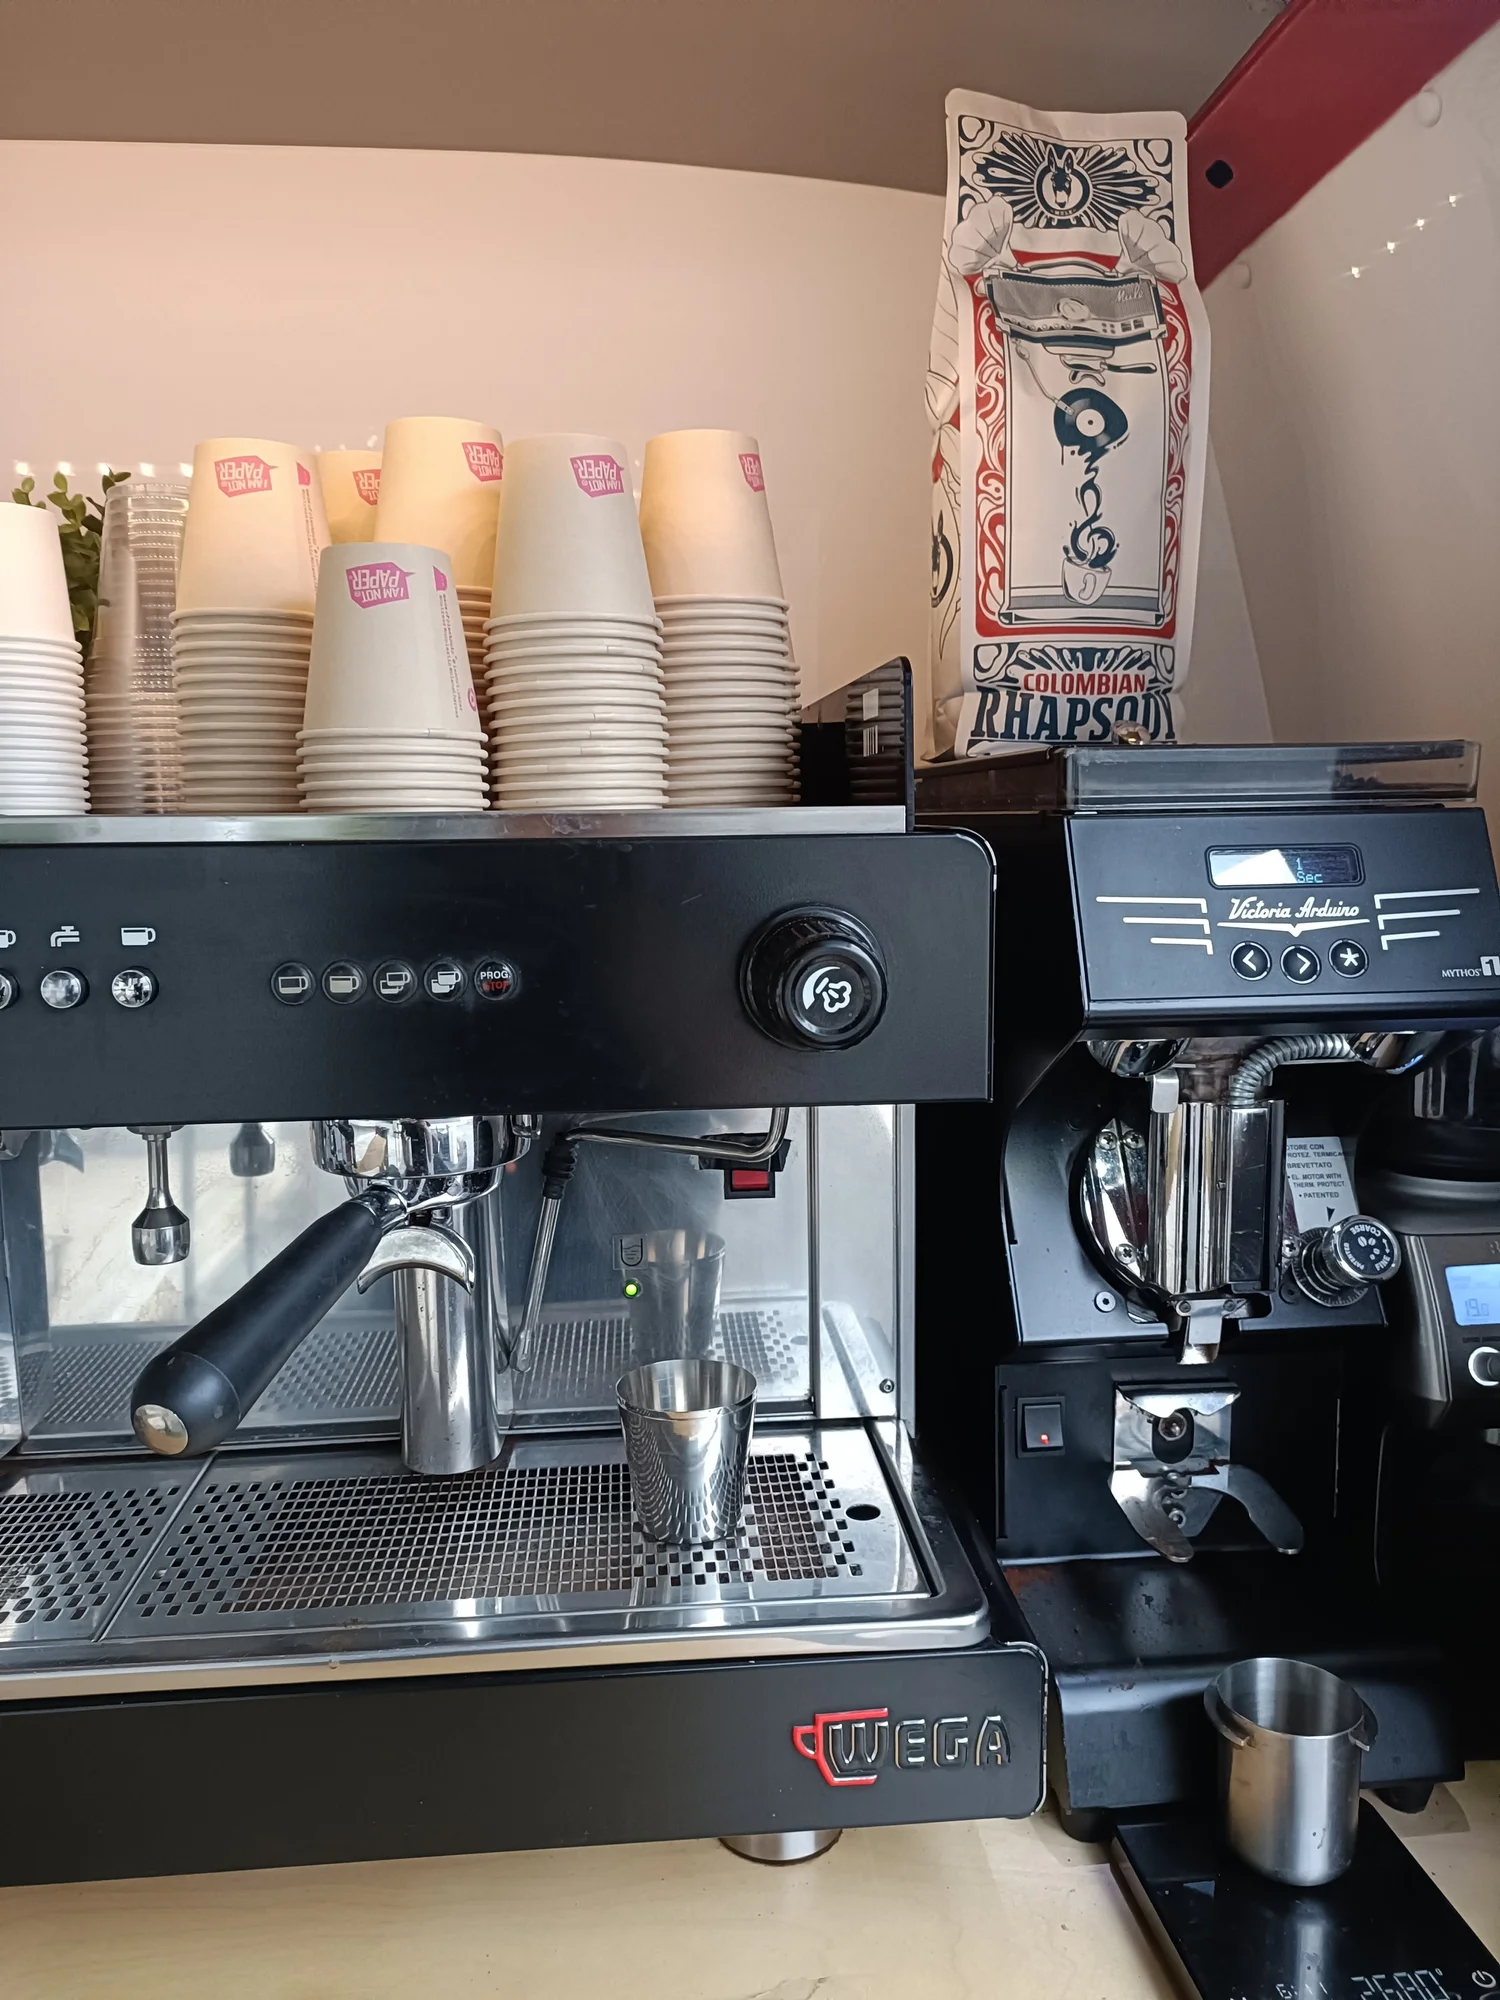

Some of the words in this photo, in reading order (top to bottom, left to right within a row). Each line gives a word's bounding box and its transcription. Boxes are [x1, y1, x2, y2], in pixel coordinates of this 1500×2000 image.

[219, 461, 264, 480] PAPER
[576, 459, 617, 480] PAPER
[351, 569, 400, 590] PAPER
[1023, 673, 1146, 695] COLOMBIAN
[1297, 870, 1323, 883] Sec
[1229, 896, 1291, 920] Victoria
[1295, 896, 1360, 918] Arduino
[1441, 968, 1480, 978] MYTHOS
[482, 980, 509, 992] STOP
[1309, 1143, 1325, 1151] CON
[1286, 1161, 1333, 1169] BREVETTATO
[1303, 1191, 1340, 1199] PATENTED
[1349, 1224, 1381, 1237] COARSE
[1374, 1254, 1391, 1271] FINE
[828, 1715, 1011, 1773] WEGA
